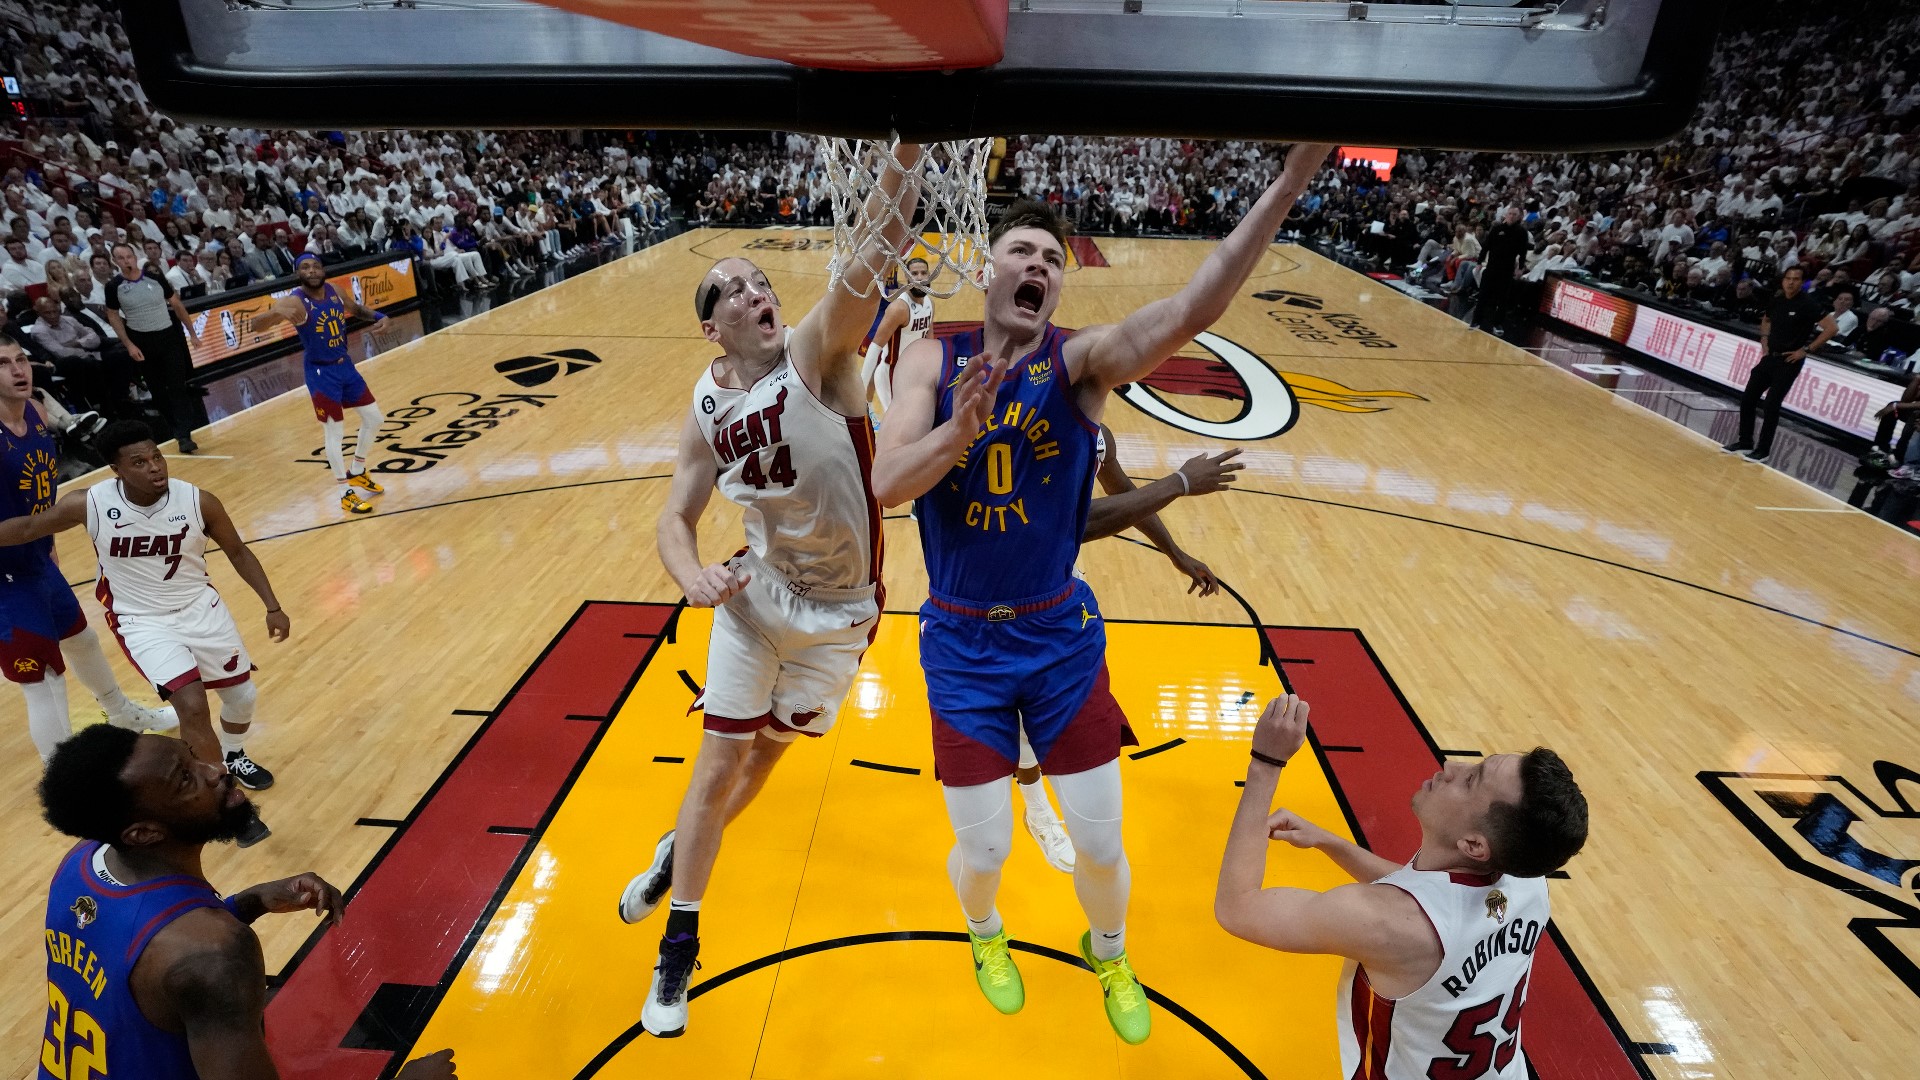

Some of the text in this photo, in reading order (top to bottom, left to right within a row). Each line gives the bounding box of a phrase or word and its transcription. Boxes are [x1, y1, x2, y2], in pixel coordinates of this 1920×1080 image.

[361, 271, 394, 306] Finals
[327, 319, 340, 337] 11
[328, 335, 344, 348] CITY
[1267, 310, 1338, 345] Center
[1316, 312, 1398, 348] Kaseya
[1645, 317, 1683, 359] JULY
[1679, 326, 1716, 370] 7-17
[956, 356, 968, 367] 6
[1028, 357, 1052, 375] WU
[370, 393, 559, 474] Kaseya
[713, 386, 789, 464] HEAT
[1003, 402, 1060, 461] HIGH
[19, 449, 58, 490] MILE HIGH
[741, 444, 797, 490] 44
[987, 443, 1013, 495] 0
[35, 470, 51, 500] 15
[168, 514, 187, 522] UKG
[965, 498, 1029, 532] CITY
[110, 523, 189, 558] HEAT
[163, 555, 182, 581] 7
[45, 928, 108, 1001] GREEN
[1441, 918, 1546, 998] ROBINSO
[40, 980, 108, 1080] 32
